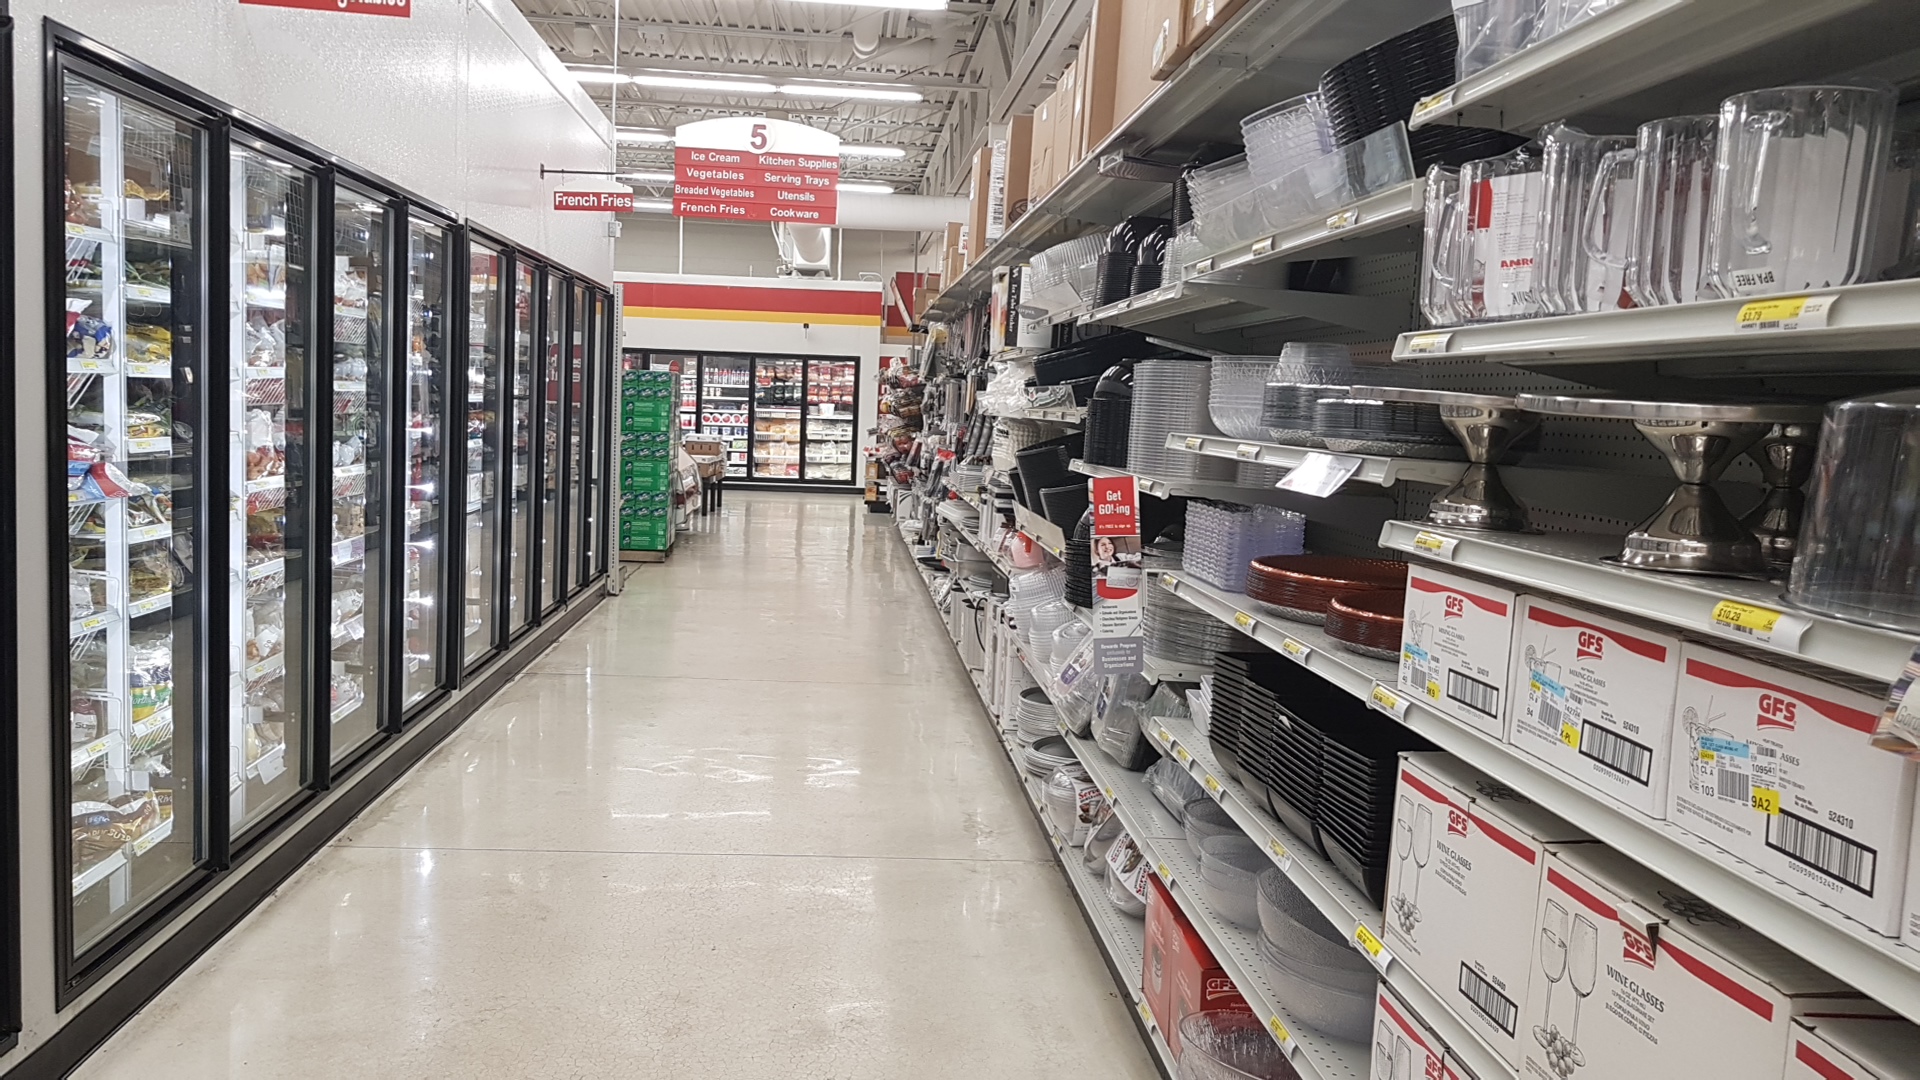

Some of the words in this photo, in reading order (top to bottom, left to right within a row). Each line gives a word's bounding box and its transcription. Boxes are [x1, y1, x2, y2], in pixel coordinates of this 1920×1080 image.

[750, 124, 767, 149] 5
[691, 151, 706, 161] Ice
[709, 152, 740, 163] Cream
[759, 155, 795, 167] Kitchen
[798, 157, 838, 169] Supplies
[686, 168, 744, 181] Vegetables
[764, 172, 801, 186] Serving
[805, 175, 830, 187] Trays
[675, 185, 708, 196] Breaded
[710, 187, 754, 199] Vegetables
[778, 191, 815, 202] Utensils
[555, 193, 598, 207] French
[601, 194, 631, 207] Fries
[680, 202, 716, 214] French
[720, 204, 745, 215] Fries
[770, 208, 819, 219] Cookware
[1735, 274, 1756, 287] FREE
[1760, 271, 1774, 285] BPA
[1106, 490, 1122, 501] Get
[1445, 595, 1464, 613] GFS
[1718, 608, 1741, 622] $10.29
[1578, 631, 1603, 653] GFS
[1759, 694, 1797, 722] GFS
[1701, 785, 1715, 797] 103
[1751, 796, 1771, 812] 9A2
[1449, 810, 1468, 832] GFS
[1828, 810, 1854, 829] 524310
[1437, 840, 1450, 856] WINE
[1450, 850, 1472, 871] GLASSES
[1623, 931, 1655, 962] GFS
[1606, 964, 1629, 989] WINE
[1629, 981, 1665, 1013] GLASSES
